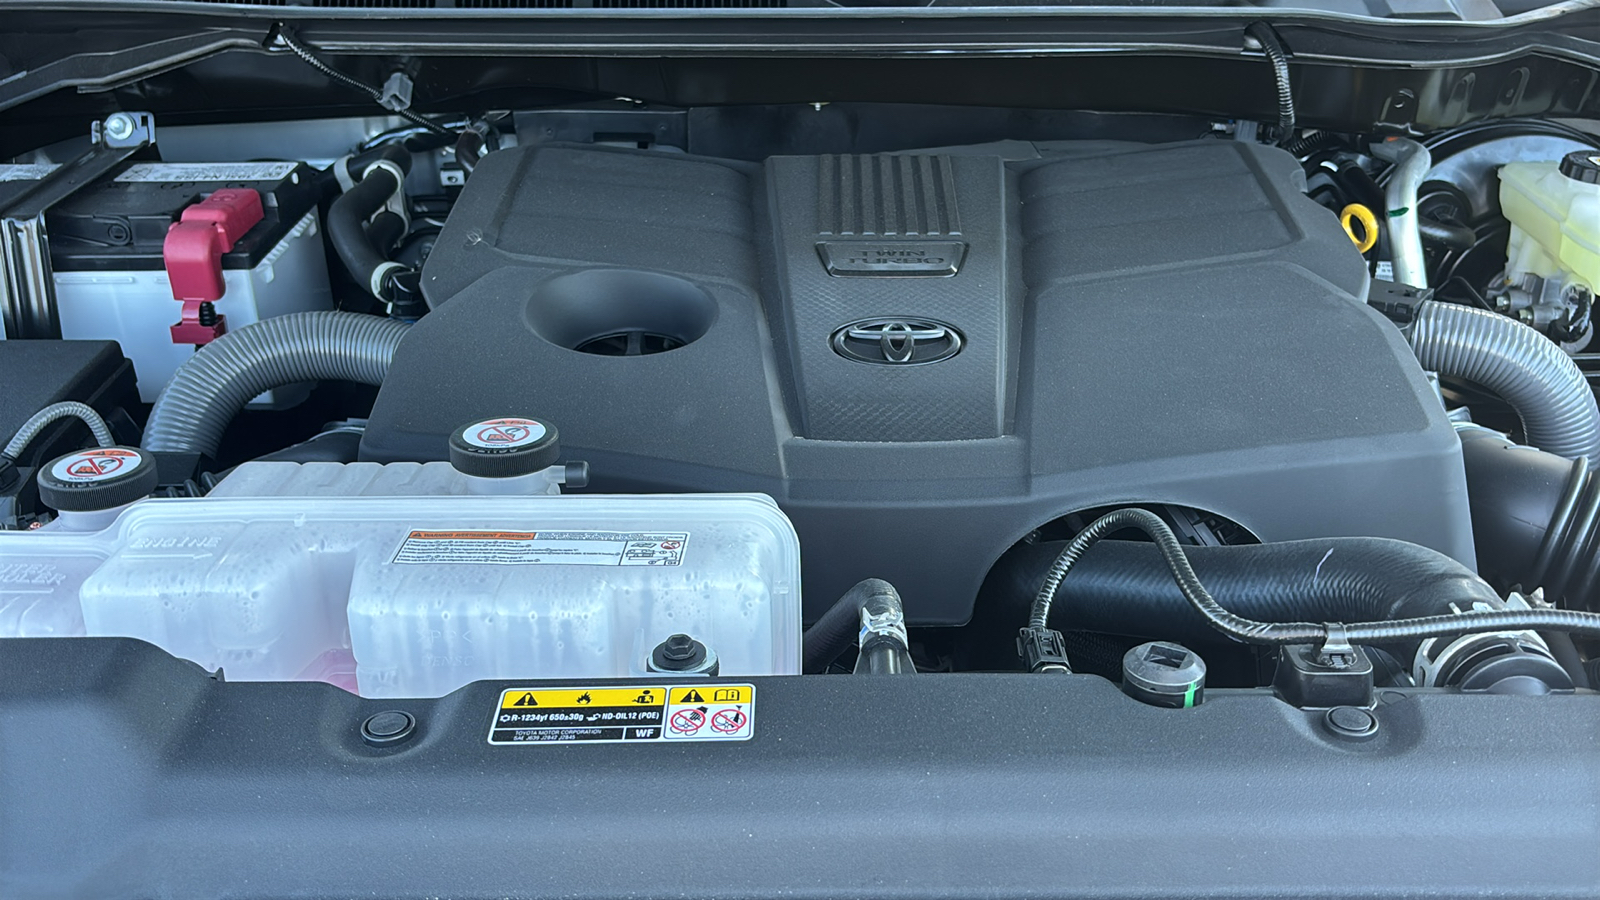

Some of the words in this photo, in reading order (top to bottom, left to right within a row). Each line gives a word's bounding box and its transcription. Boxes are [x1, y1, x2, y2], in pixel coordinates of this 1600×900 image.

[130, 536, 222, 549] ENGINE
[511, 714, 548, 722] R-1234yf
[549, 713, 584, 721] 650±30g
[638, 712, 660, 720] (POE)
[635, 729, 654, 738] WF
